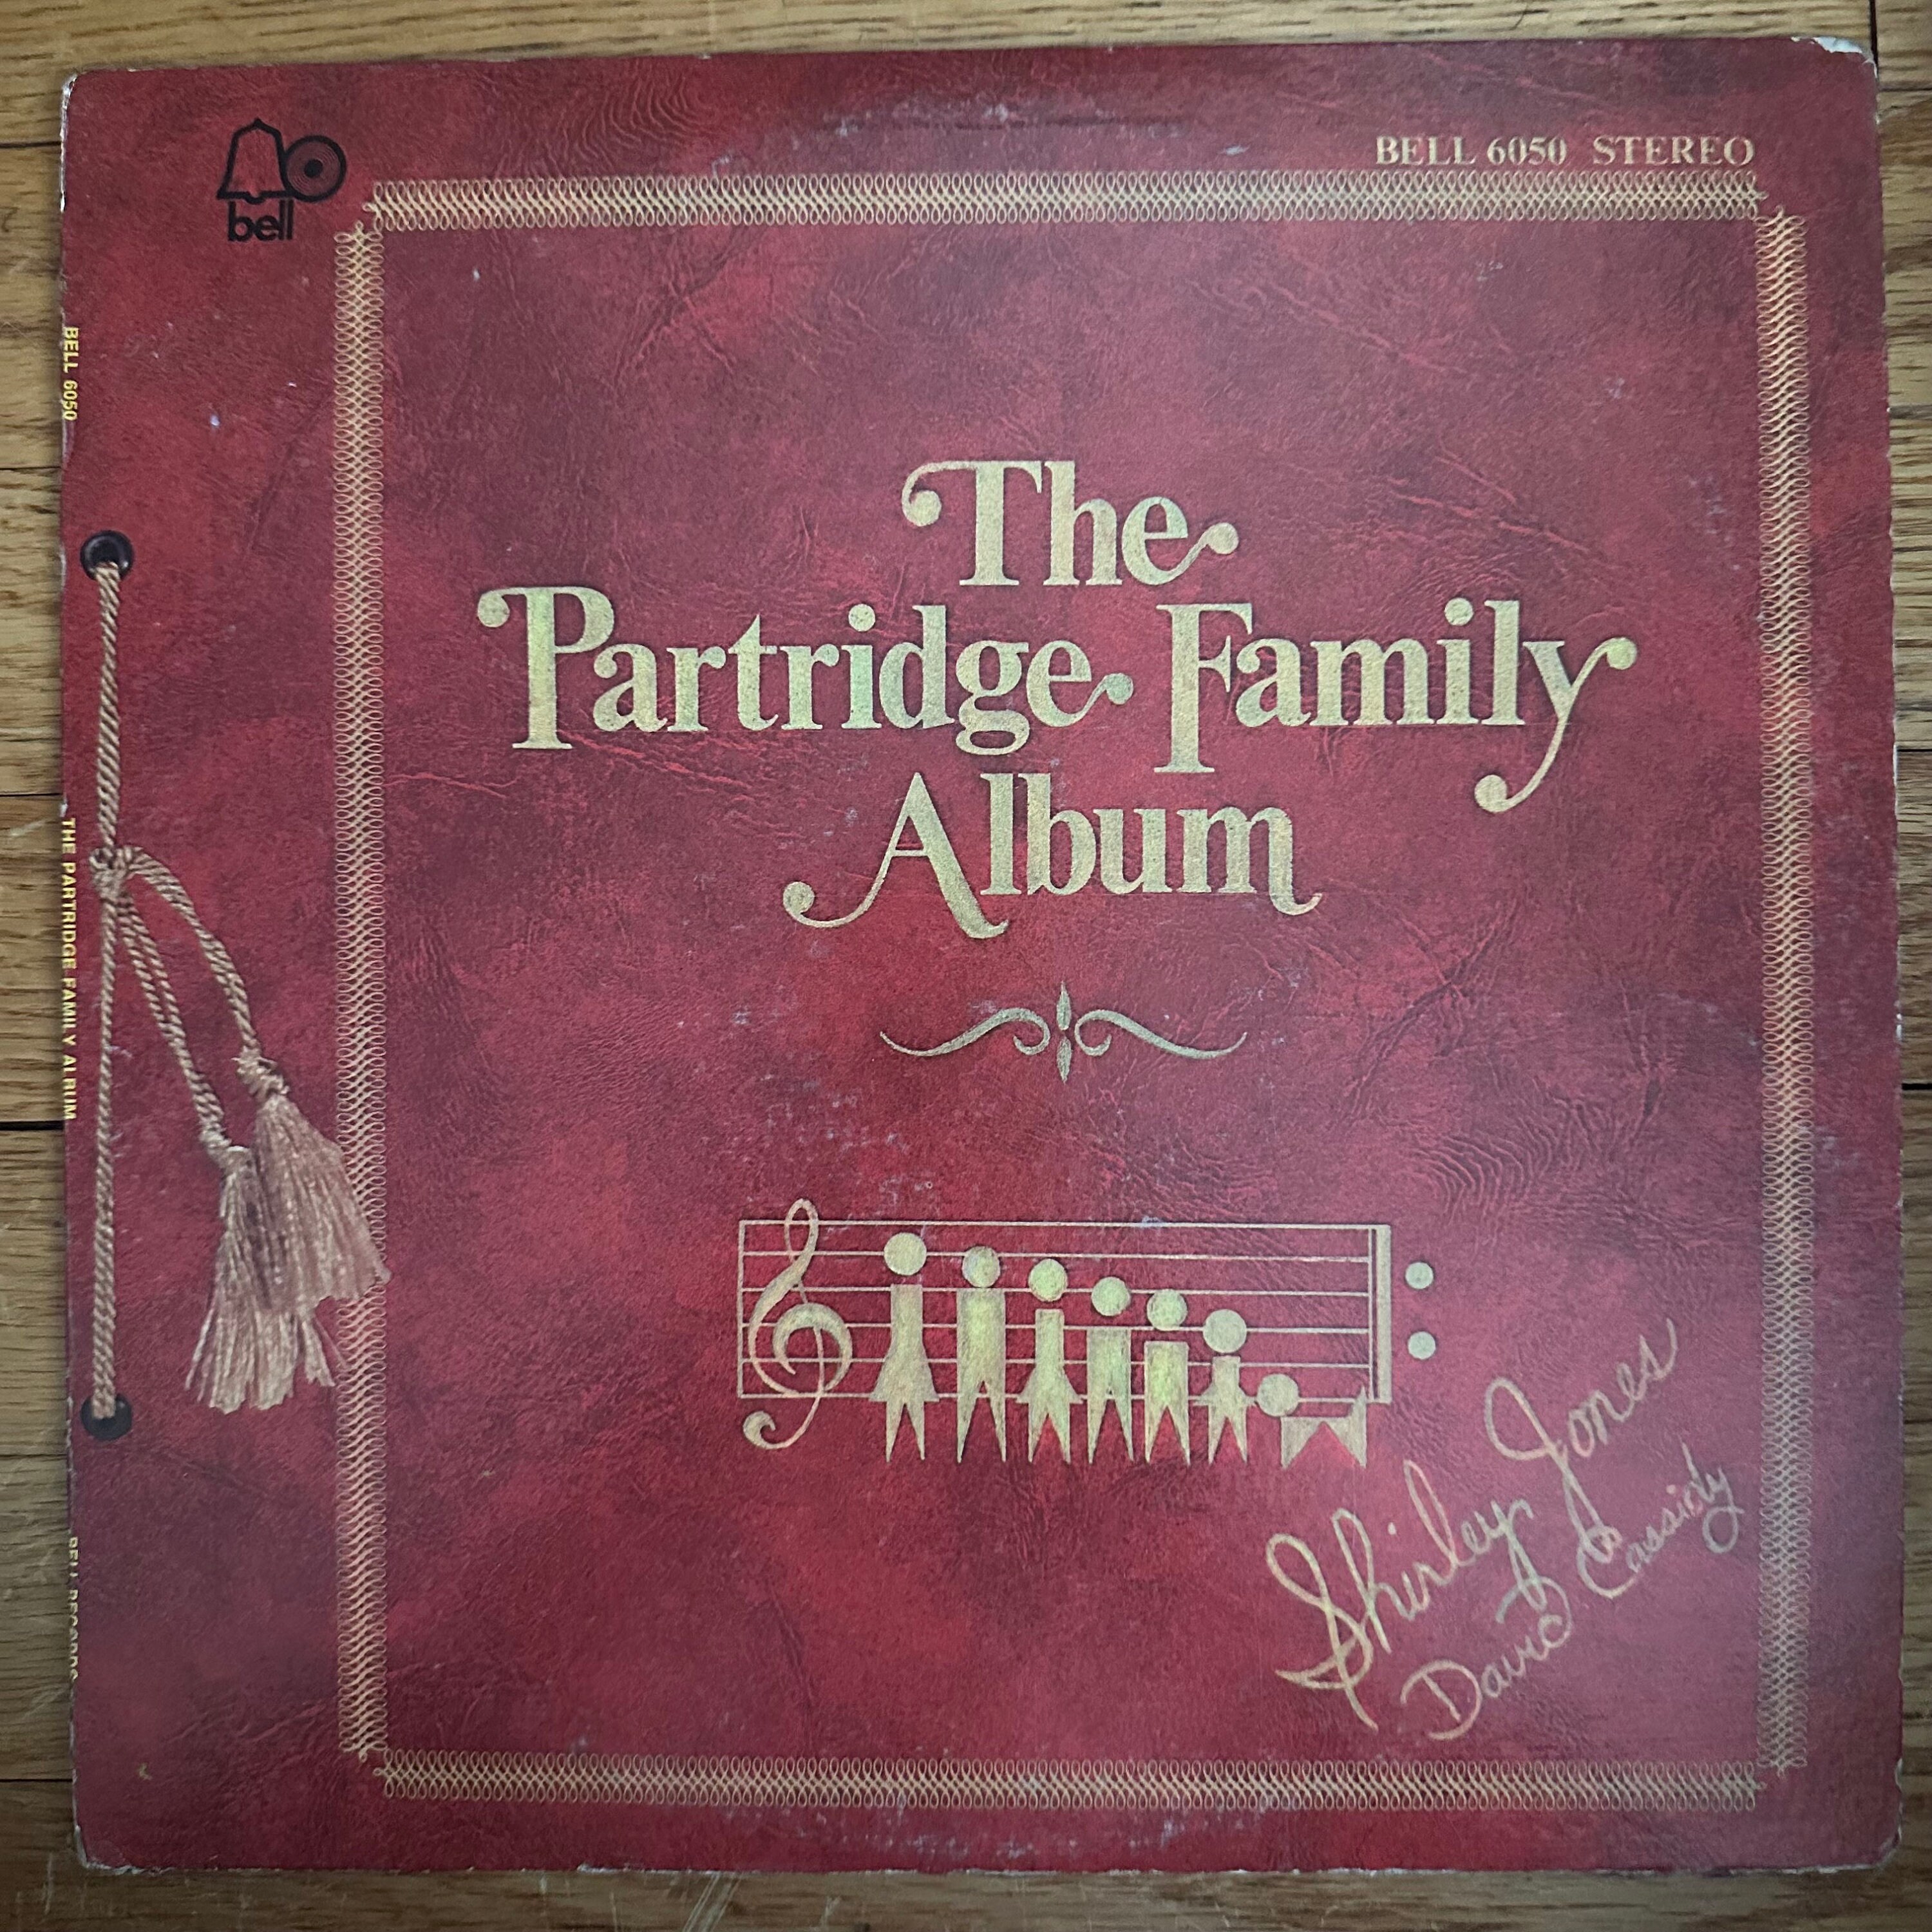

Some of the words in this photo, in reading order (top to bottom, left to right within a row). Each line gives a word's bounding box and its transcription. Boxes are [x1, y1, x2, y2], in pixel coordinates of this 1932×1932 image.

[1376, 135, 1477, 165] BELL
[1486, 135, 1567, 166] 6050
[1593, 135, 1756, 166] STEREO
[228, 199, 294, 242] bell
[62, 327, 79, 374] BELL
[62, 379, 79, 421] 6050
[901, 459, 1240, 588] The
[476, 585, 1135, 756] Partridge
[1153, 596, 1639, 815] Family
[62, 817, 77, 854] THE
[782, 770, 1323, 940] Album
[62, 862, 77, 969] PARTRIDGE
[62, 977, 77, 1046] FAMILY
[62, 1054, 77, 1120] ALBUM
[1265, 1458, 1548, 1734] Shirley
[1483, 1317, 1676, 1564] Jones
[1399, 1575, 1575, 1741] David
[1575, 1441, 1745, 1600] Cassidy
